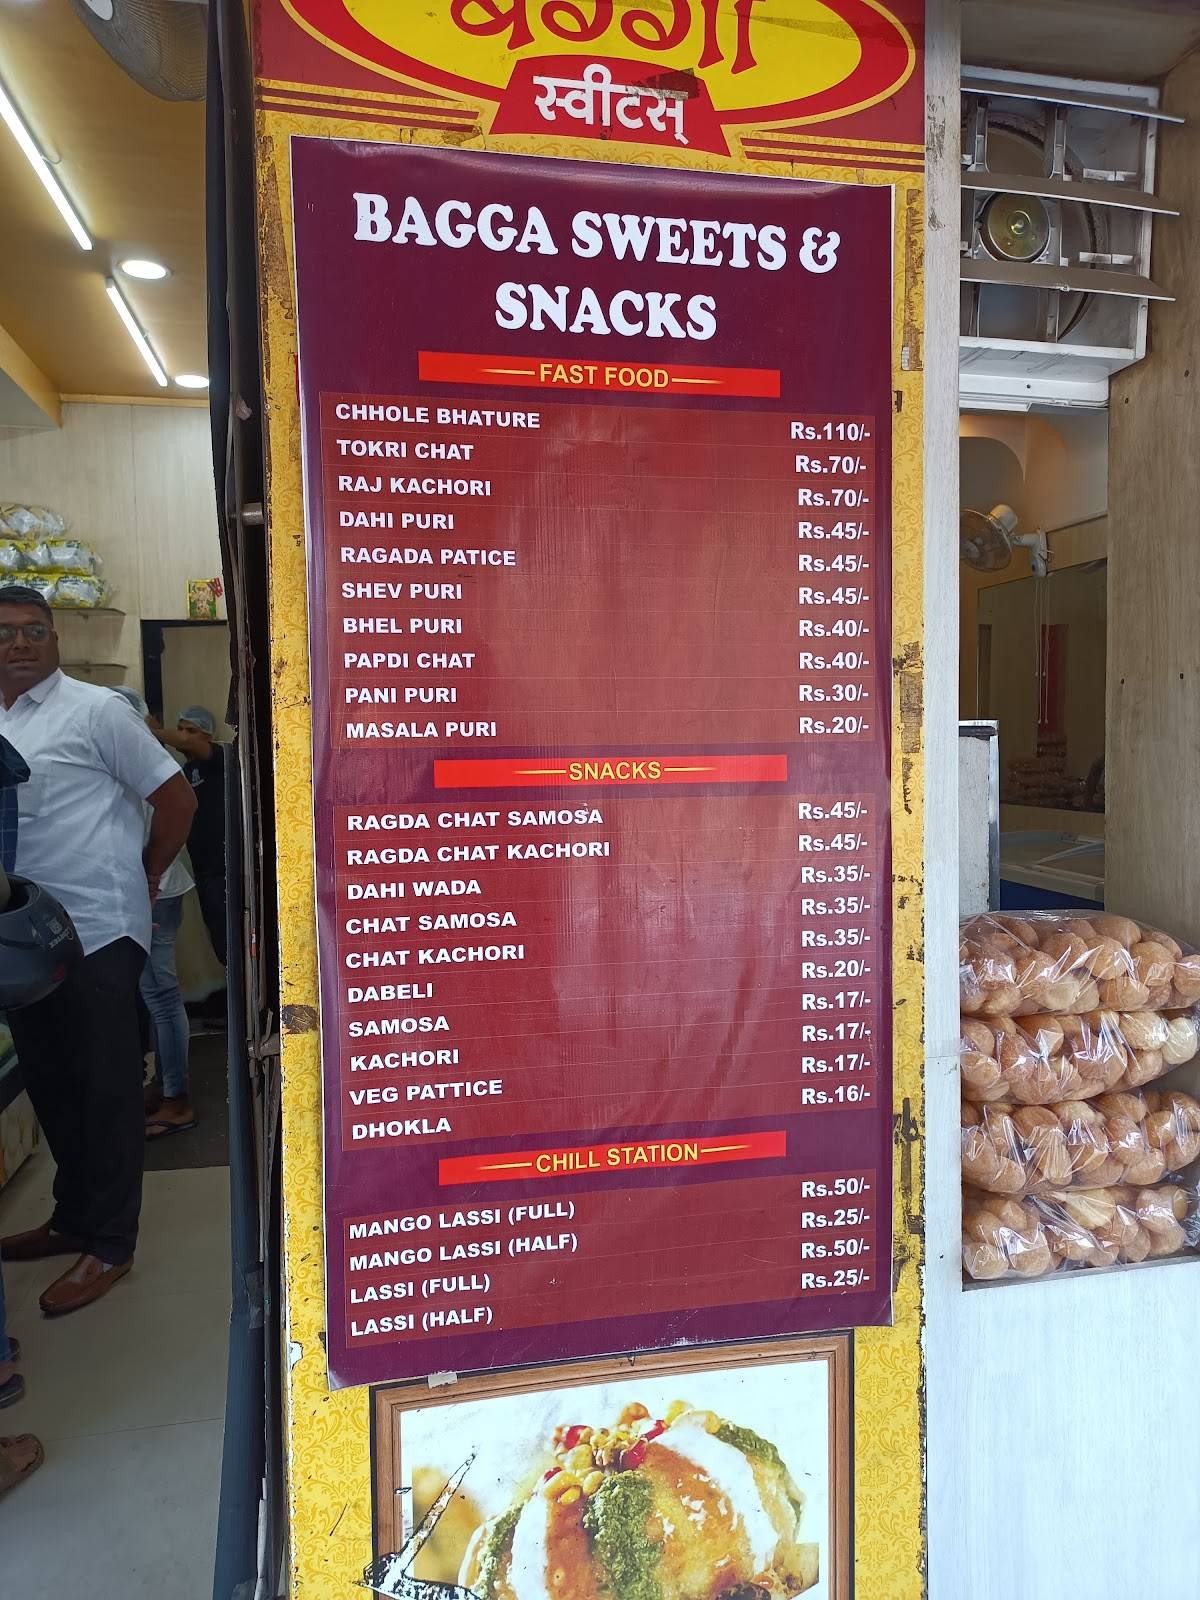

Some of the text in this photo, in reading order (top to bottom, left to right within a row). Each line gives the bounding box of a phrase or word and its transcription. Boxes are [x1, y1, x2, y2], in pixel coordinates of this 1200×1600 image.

[353, 192, 841, 274] BAGGA SWEETS &
[495, 282, 717, 340] SNACKS
[538, 363, 669, 389] FAST FOOD
[336, 403, 541, 429] CHHOLE BHATURE
[790, 421, 871, 442] Rs.110/-
[336, 439, 474, 461] TOKRI CHAT
[795, 454, 867, 475] Rs.70/-
[338, 475, 491, 497] RAJ KACHORI
[798, 488, 870, 507] Rs.70/-
[339, 510, 454, 530] DAHI PURI
[798, 521, 870, 540] Rs.45/-
[340, 546, 516, 566] RAGADA PATICE
[798, 554, 870, 573] Rs.45/-
[341, 582, 462, 600] SHEV PURI
[798, 586, 870, 605] Rs.45/-
[343, 617, 462, 634] BHEL PURI
[798, 619, 870, 638] Rs.40/-
[344, 652, 476, 669] PAPDI CHAT
[798, 651, 870, 670] Rs.40/-
[345, 687, 457, 704] PANI PURI
[798, 683, 869, 702] Rs.30/-
[346, 721, 497, 739] MASALA PURI
[798, 715, 869, 734] Rs.20/-
[568, 761, 663, 782] SNACKS
[347, 808, 604, 831] RAGDA CHAT SAMOSA
[798, 801, 868, 820] Rs.45/-
[798, 833, 868, 852] Rs.45/-
[347, 841, 610, 866] RAGDA CHAT KACHORI
[801, 864, 871, 884] Rs.35/-
[347, 879, 482, 900] DAHI WADA
[801, 895, 871, 916] Rs.35/-
[345, 911, 518, 935] CHAT SAMOSA
[801, 927, 871, 948] Rs.35/-
[345, 944, 525, 969] CHAT KACHORI
[801, 959, 871, 979] Rs.20/-
[347, 982, 433, 1003] DABELI
[802, 990, 871, 1011] Rs.17/-
[348, 1015, 450, 1038] SAMOSA
[802, 1021, 871, 1042] Rs.17/-
[350, 1048, 459, 1072] KACHORI
[801, 1052, 871, 1074] Rs.17/-
[349, 1079, 503, 1106] VEG PATTICE
[801, 1084, 871, 1105] Rs.16/-
[352, 1117, 452, 1140] DHOKLA
[535, 1142, 698, 1173] CHILL STATION
[801, 1177, 871, 1199] Rs.50/-
[349, 1200, 575, 1240] MANGO LASSI (FULL)
[801, 1207, 871, 1229] Rs.25/-
[349, 1232, 578, 1272] MANGO LASSI (HALF)
[801, 1237, 870, 1260] Rs.50/-
[350, 1273, 491, 1304] LASSI (FULL)
[801, 1267, 870, 1290] Rs.25/-
[350, 1306, 493, 1337] LASSI (HALF)
